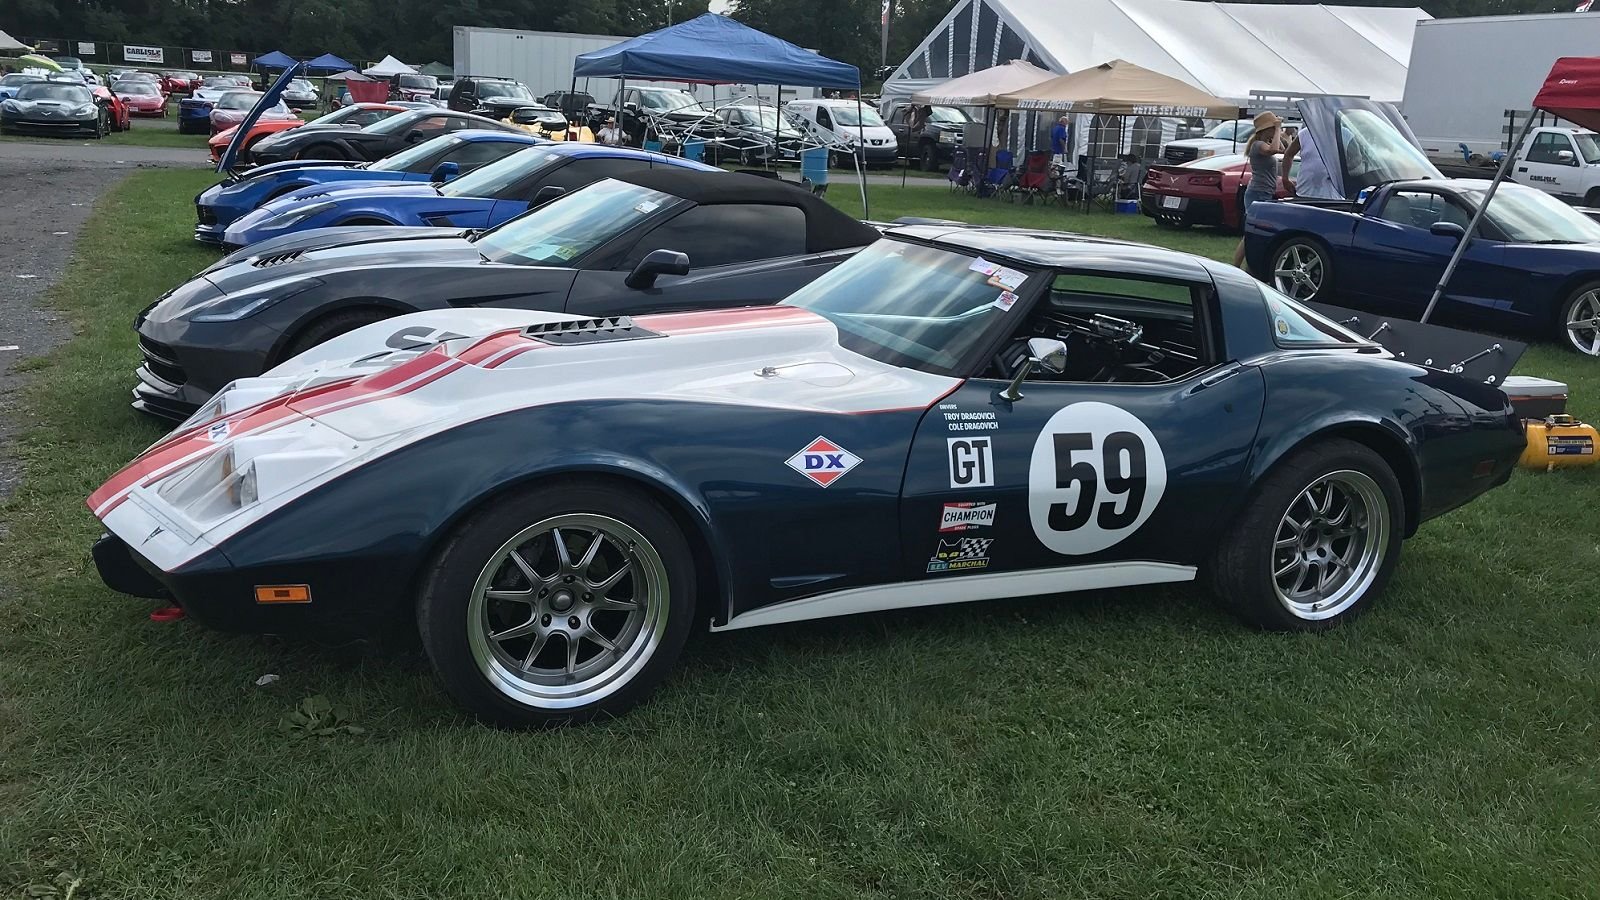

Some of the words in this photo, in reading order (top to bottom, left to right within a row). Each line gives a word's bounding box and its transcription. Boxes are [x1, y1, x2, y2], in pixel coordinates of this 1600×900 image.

[1132, 105, 1158, 115] VETTE
[1159, 106, 1175, 116] SET
[1175, 106, 1208, 118] SOCIETY
[944, 412, 960, 421] TROY
[960, 412, 996, 420] DRAGOVICH
[948, 423, 964, 431] COLE
[964, 421, 999, 430] DRAGOVICH
[804, 454, 846, 470] DX
[952, 440, 988, 484] GT
[1047, 431, 1147, 532] 59
[943, 509, 993, 523] CHAMPION
[949, 560, 986, 569] MARCHAL
